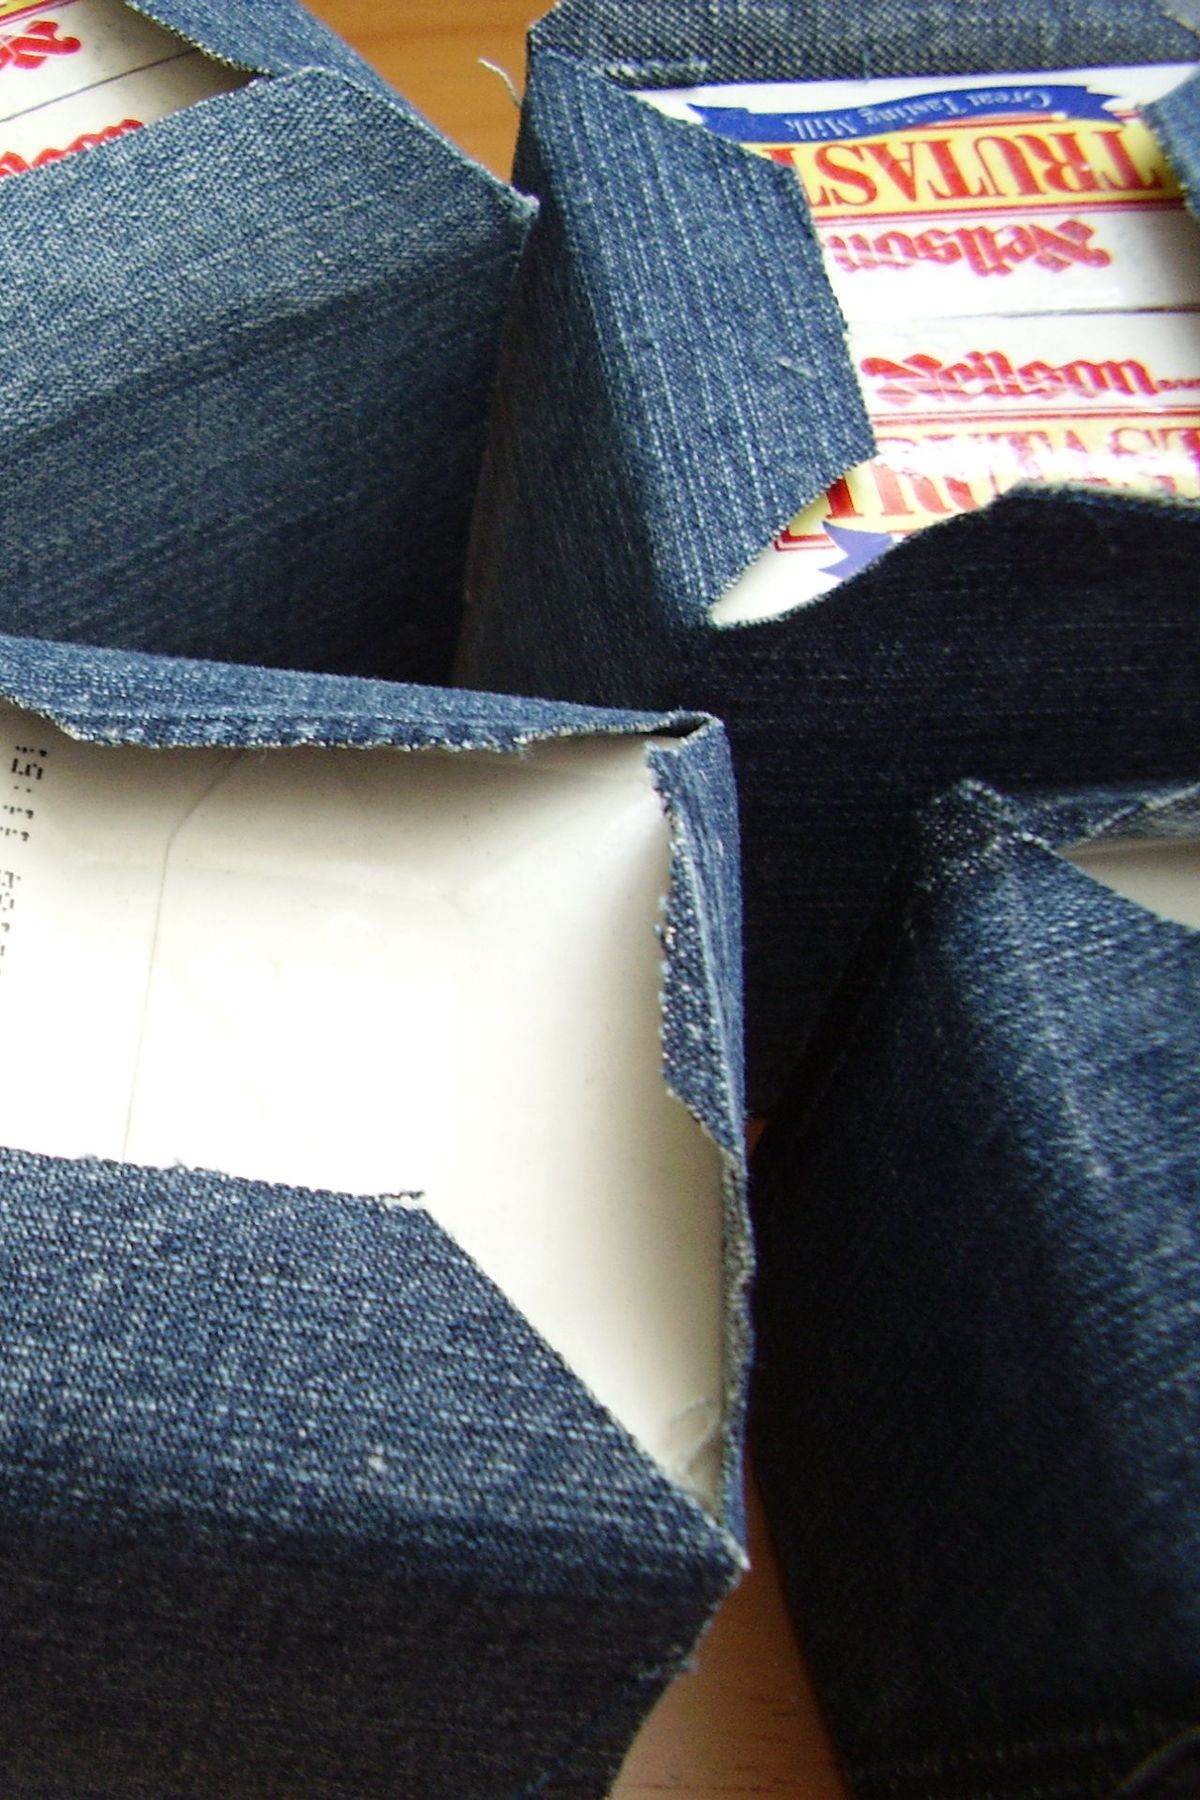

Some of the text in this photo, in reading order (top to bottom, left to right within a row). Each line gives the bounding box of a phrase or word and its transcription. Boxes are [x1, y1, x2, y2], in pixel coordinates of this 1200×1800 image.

[785, 115, 858, 141] Milk
[859, 94, 968, 129] Tasting
[824, 218, 1113, 278] Neilson
